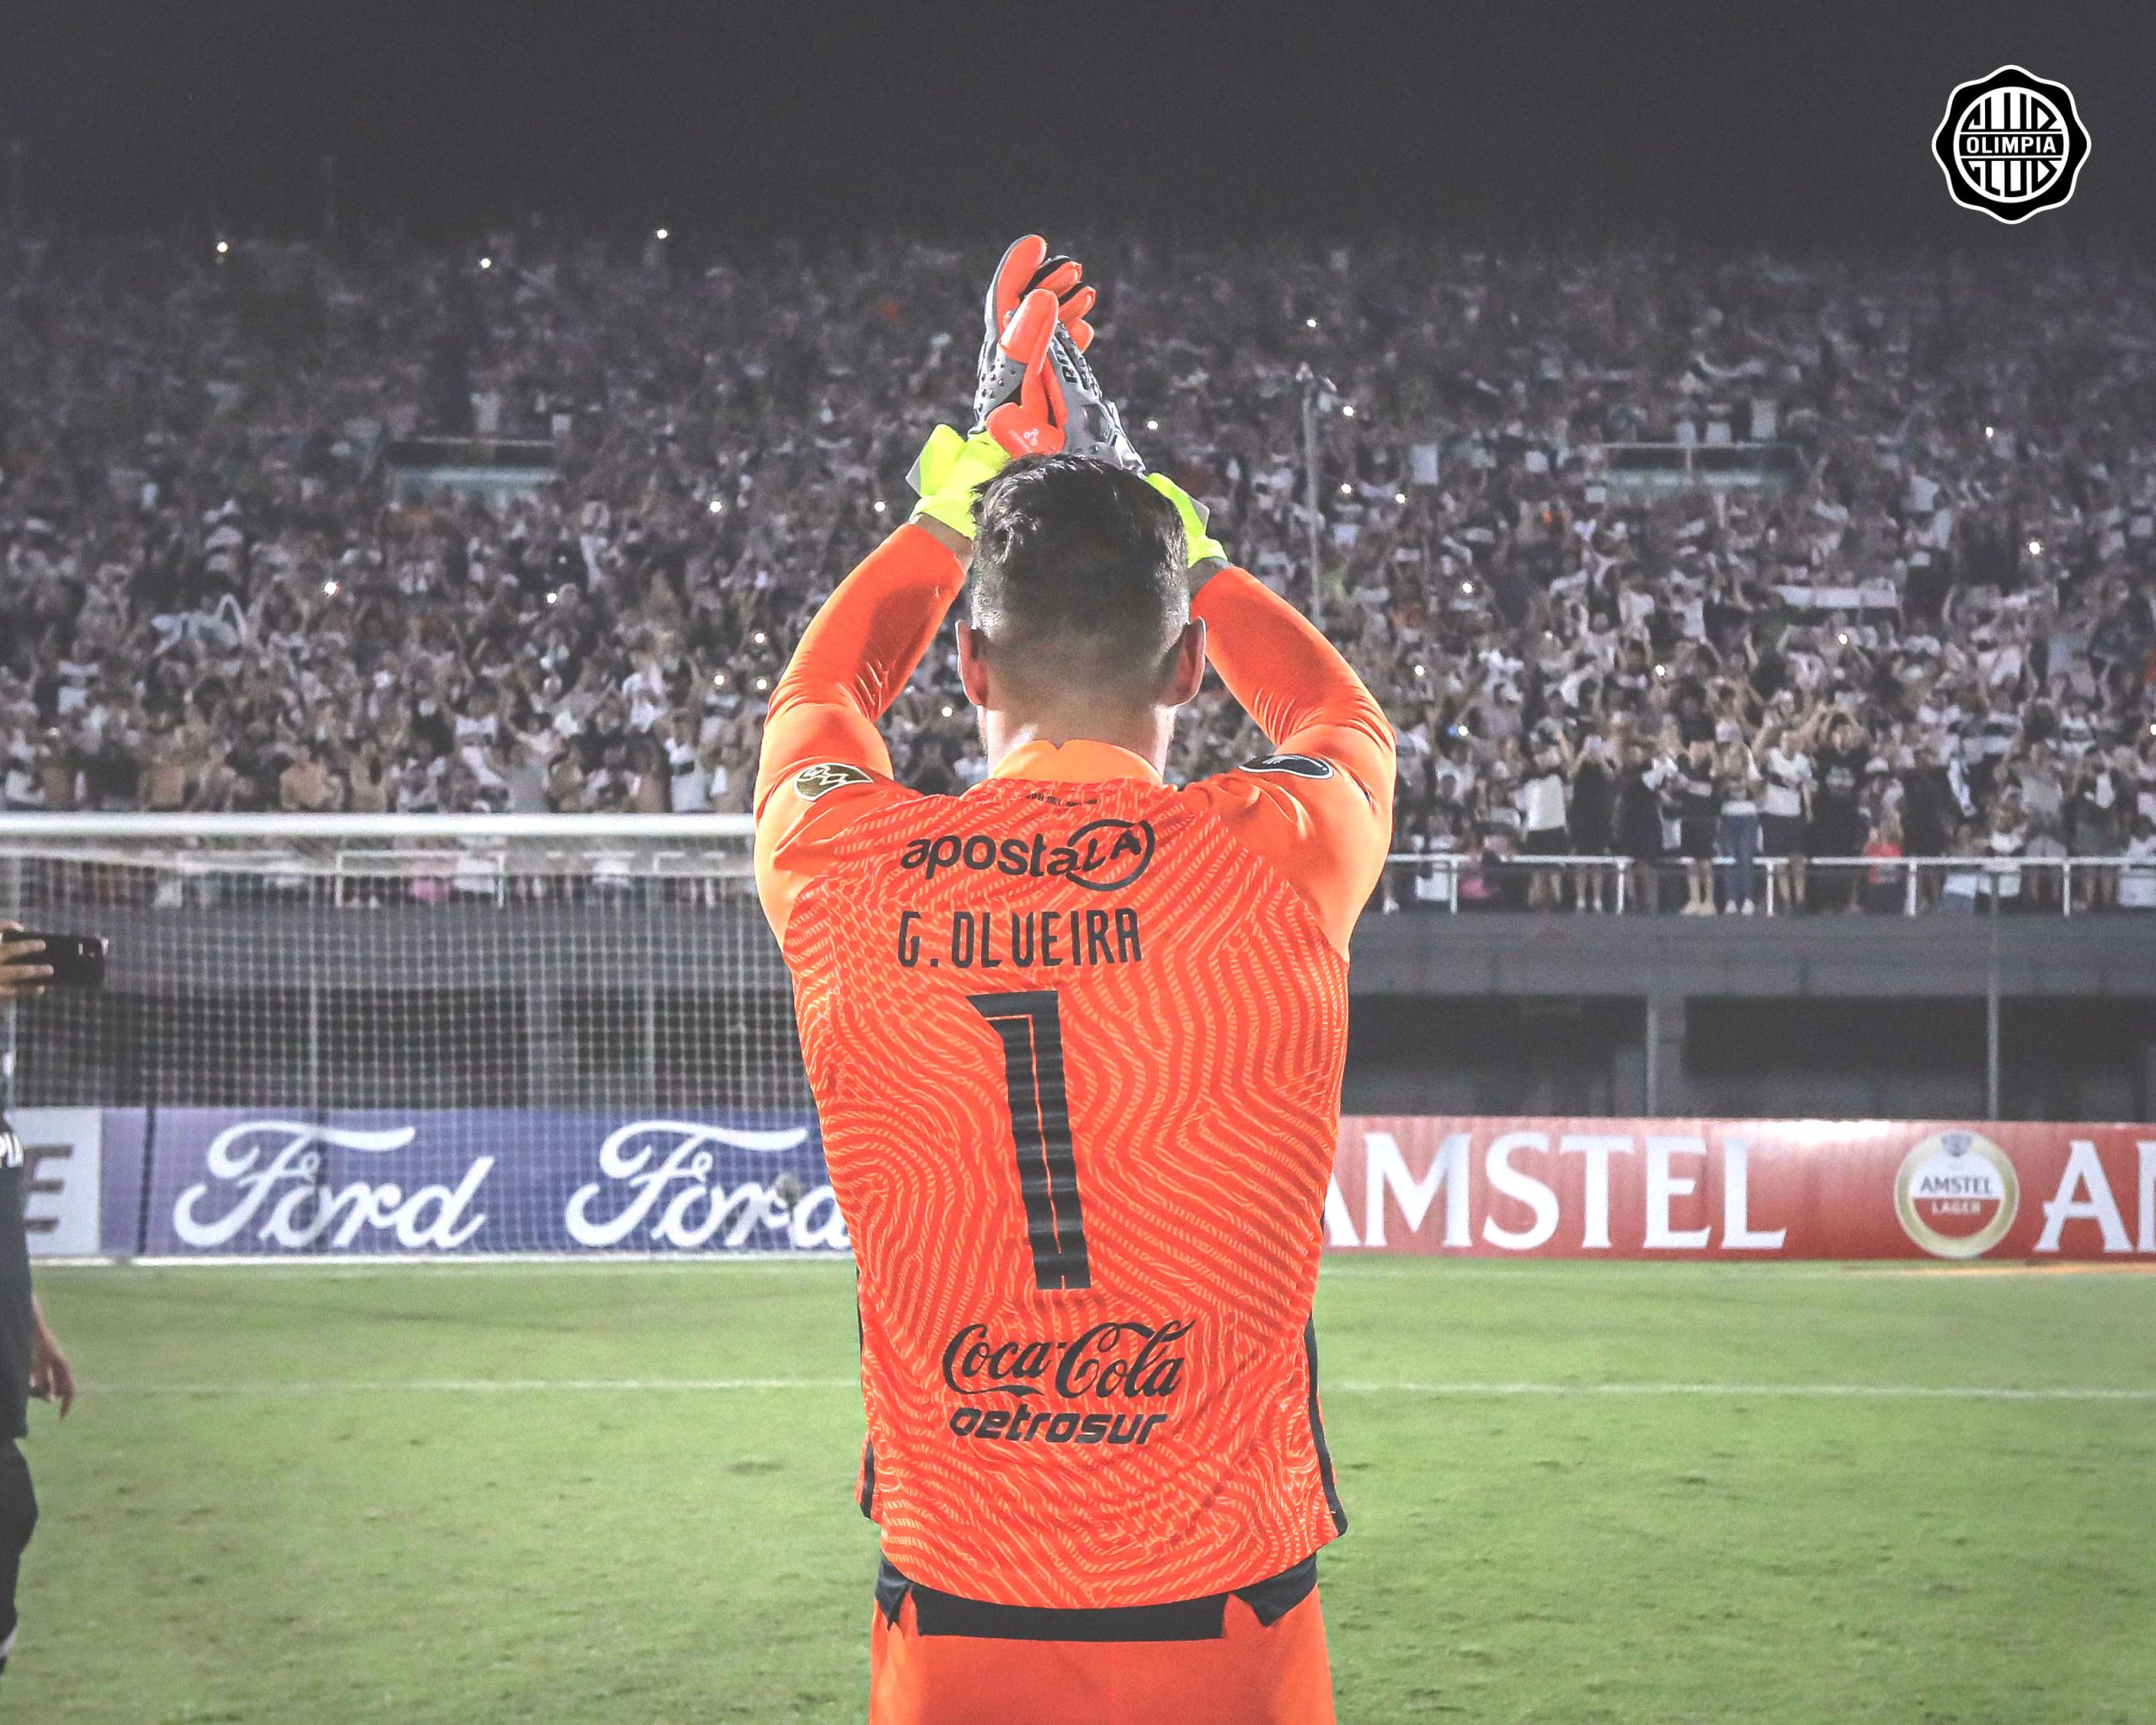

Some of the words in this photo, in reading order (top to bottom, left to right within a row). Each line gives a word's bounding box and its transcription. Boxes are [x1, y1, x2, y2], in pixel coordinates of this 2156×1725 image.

[173, 1120, 495, 1248] Ford
[966, 990, 1091, 1290] 1
[1919, 1176, 1993, 1194] AMSTEL
[2033, 1140, 2156, 1252] A
[942, 1319, 1196, 1399] Coca-Cola
